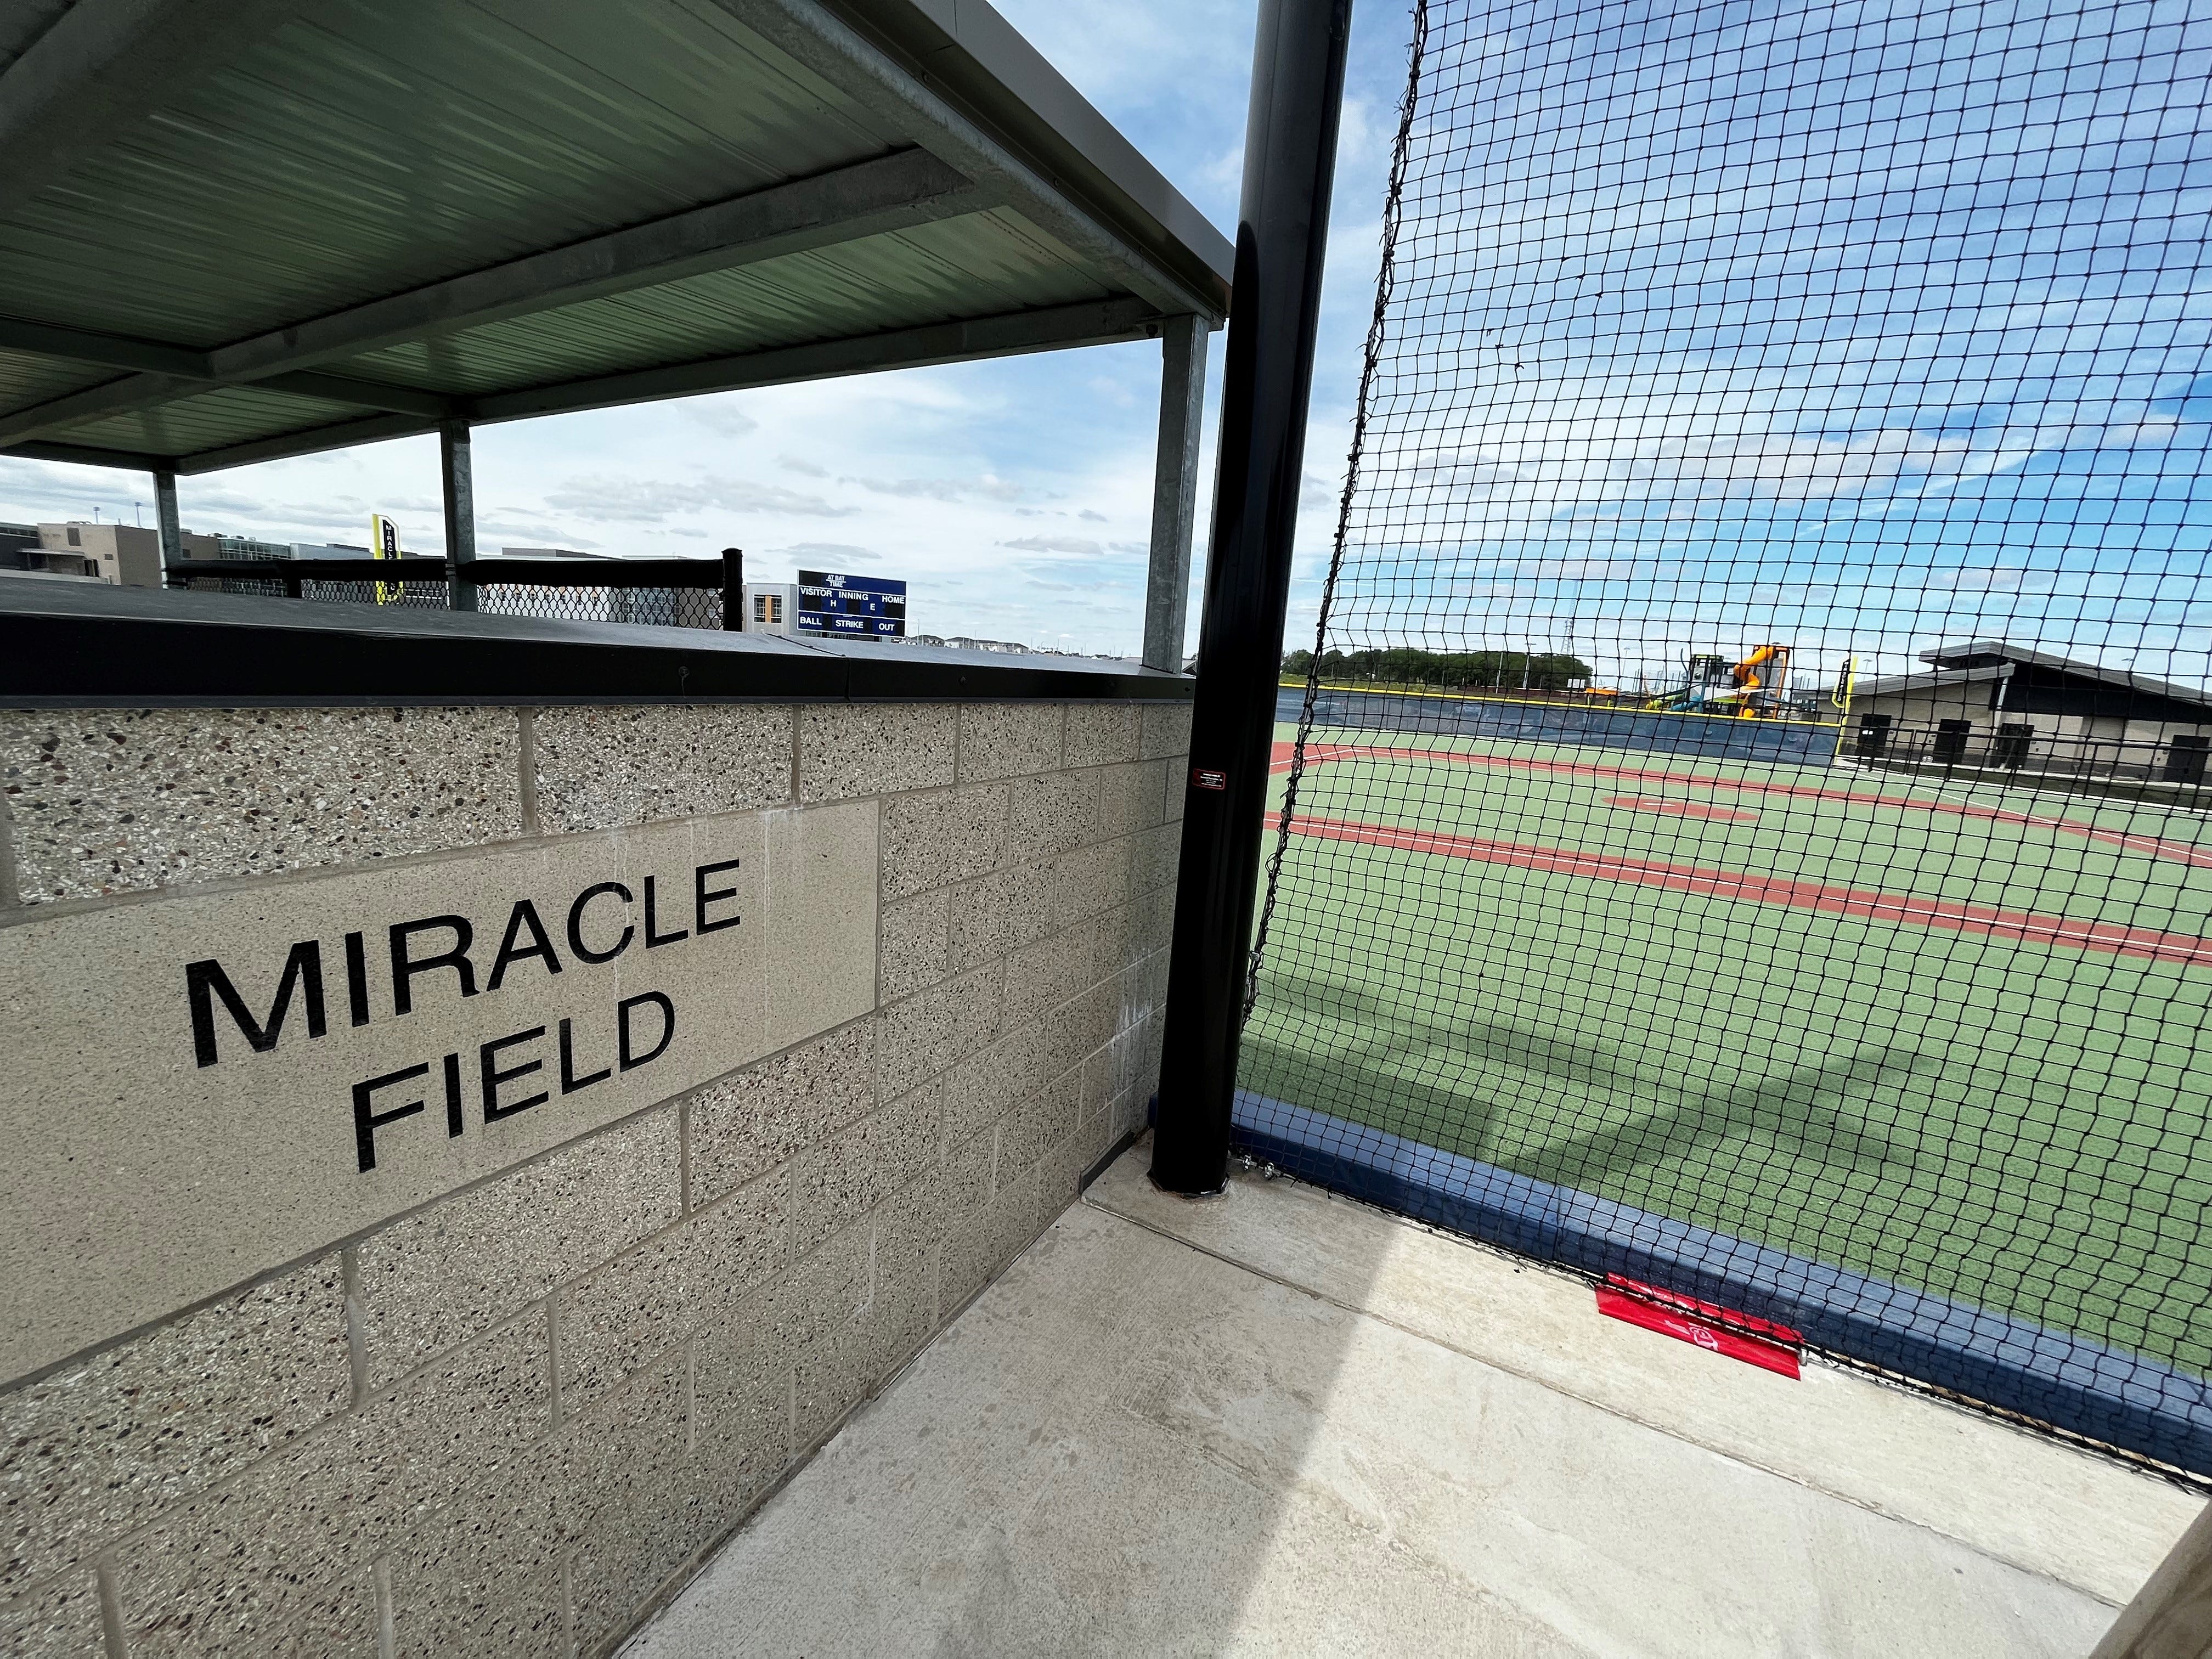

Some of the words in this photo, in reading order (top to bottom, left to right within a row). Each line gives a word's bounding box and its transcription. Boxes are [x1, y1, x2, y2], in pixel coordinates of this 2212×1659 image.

[800, 587, 832, 597] VISITOR
[838, 591, 868, 601] INNING
[882, 595, 905, 605] HOME
[800, 616, 822, 625] BALL
[836, 619, 864, 629] STRIKE
[878, 623, 895, 631] OUT
[186, 859, 740, 1068] MIRACLE
[352, 991, 674, 1173] FIELD
